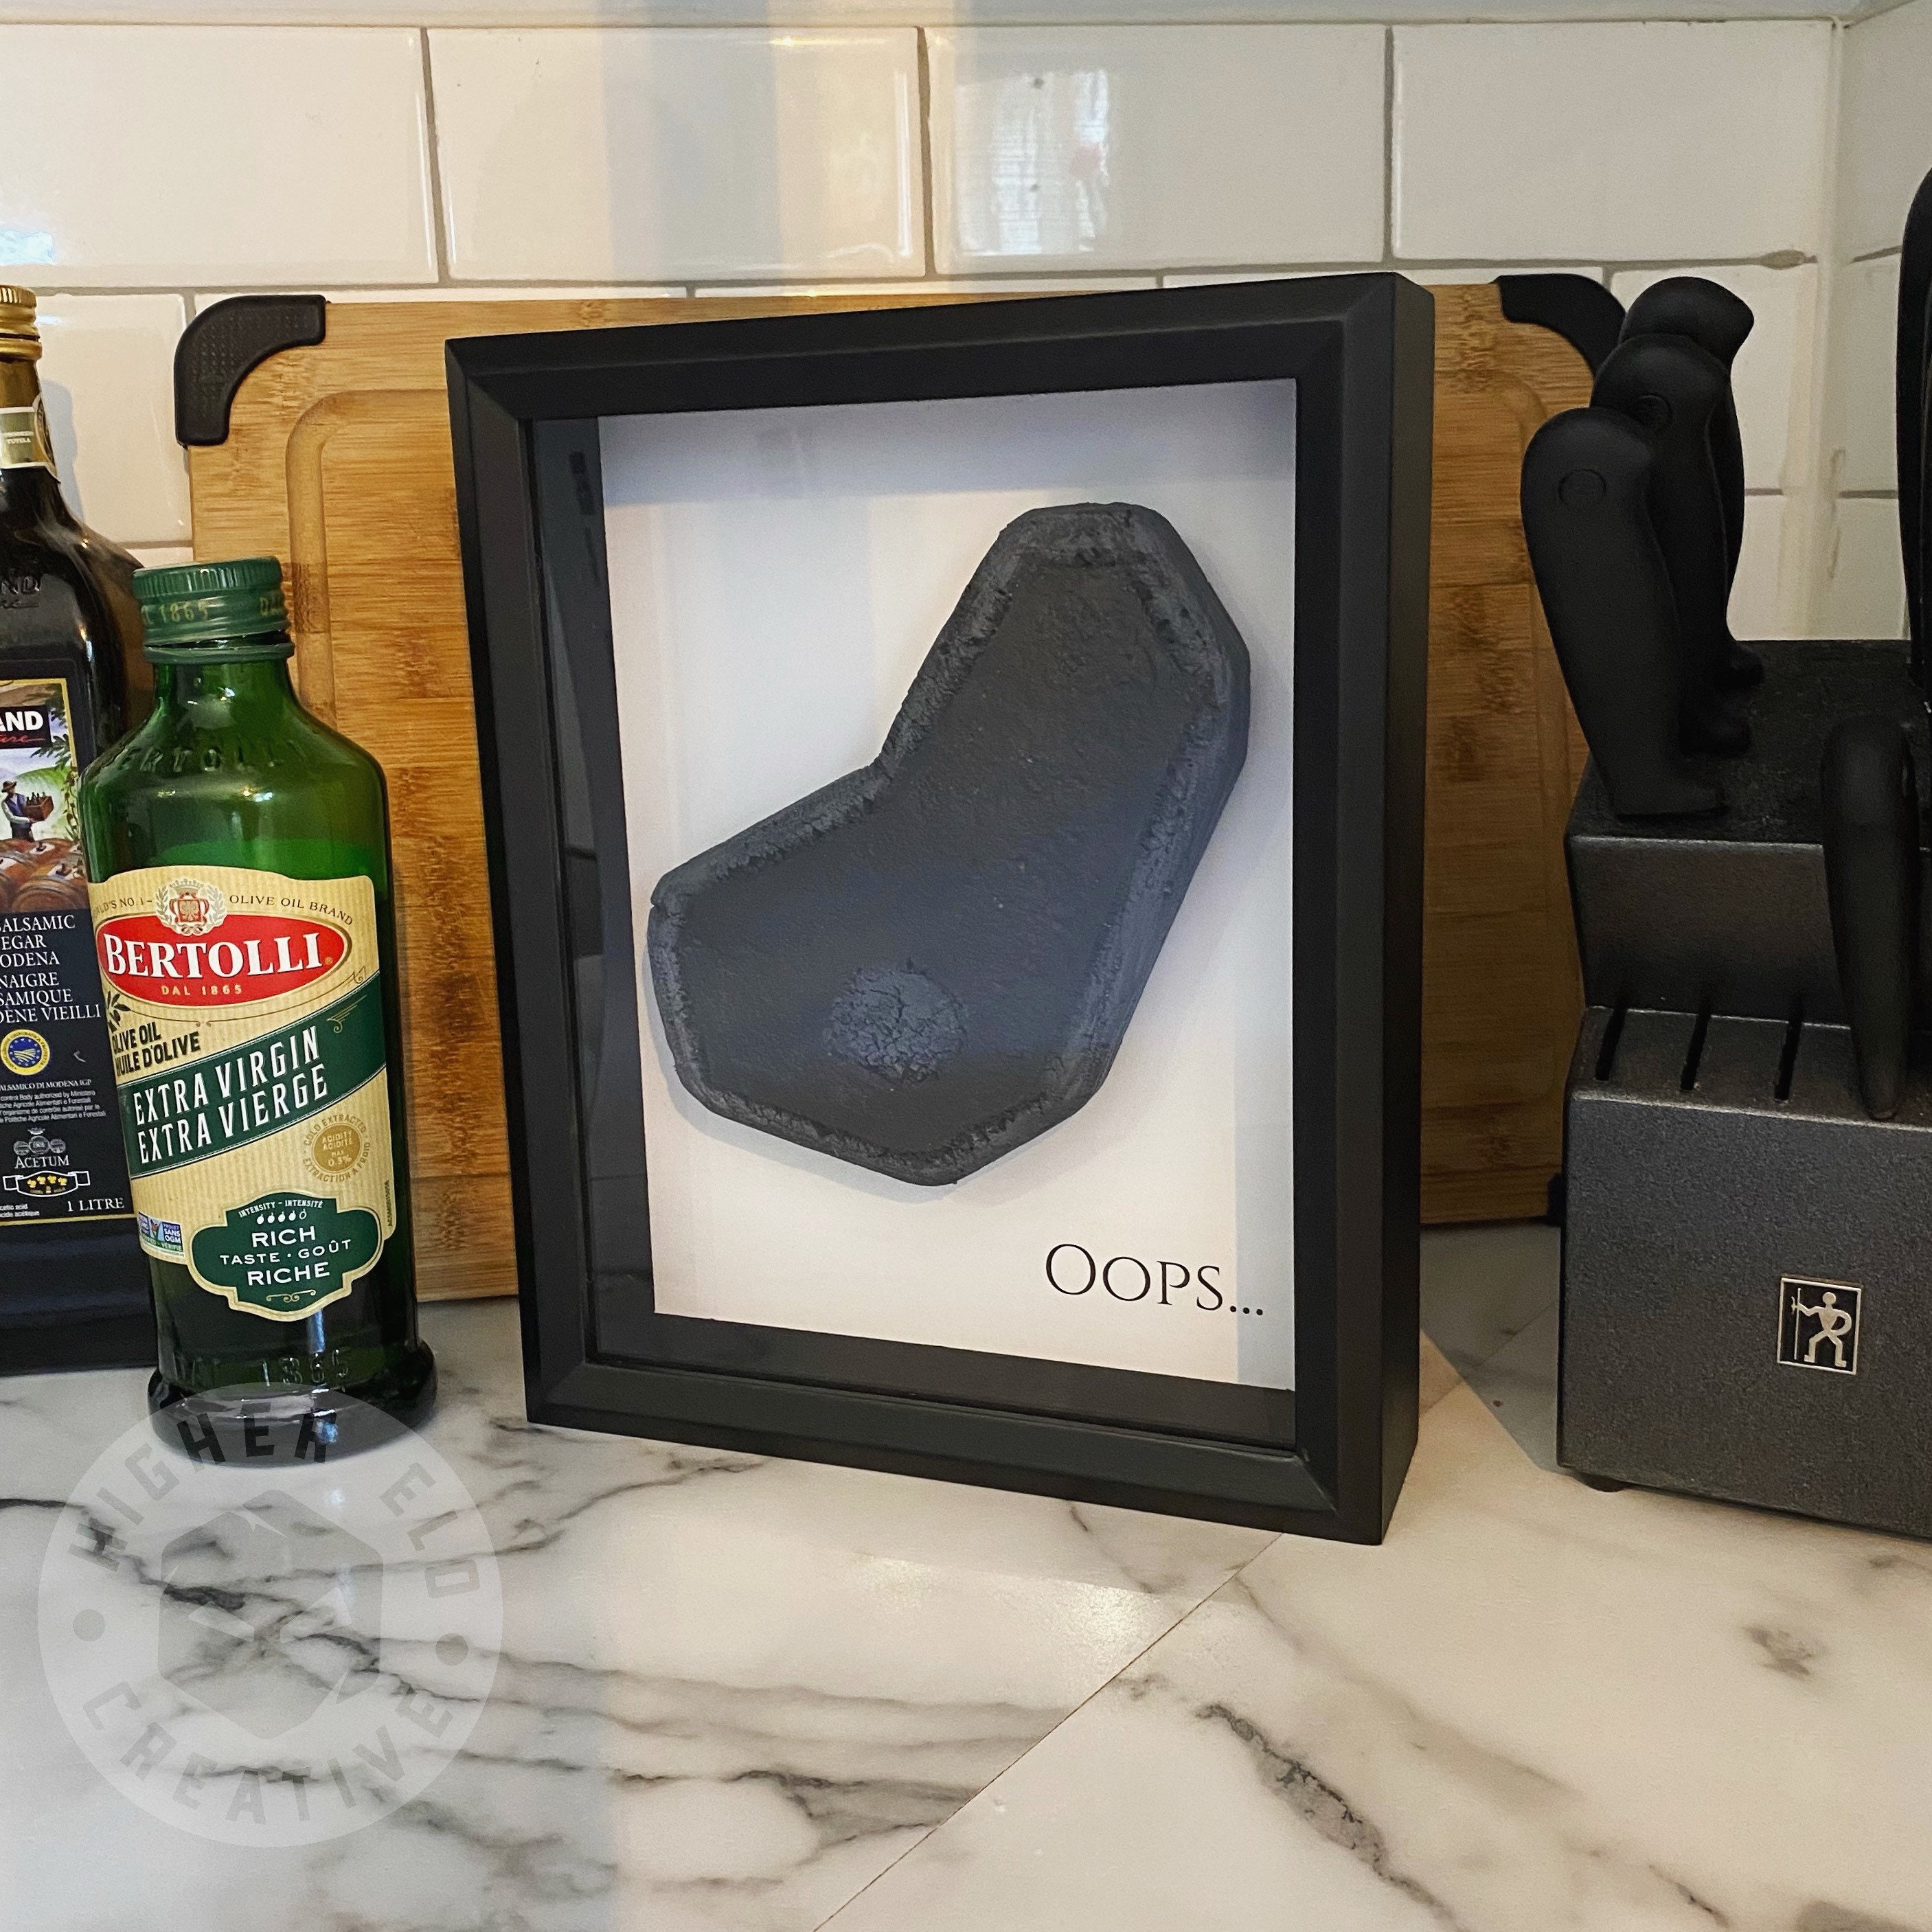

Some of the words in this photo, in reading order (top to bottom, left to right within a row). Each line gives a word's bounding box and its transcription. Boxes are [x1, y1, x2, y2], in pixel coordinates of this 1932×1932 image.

[229, 895, 275, 905] OLIVE
[280, 898, 304, 909] OIL
[309, 901, 353, 925] BRAND
[0, 914, 76, 933] ALSAMIC
[103, 933, 323, 979] BERTOLLI
[161, 985, 191, 996] DAL
[202, 984, 242, 996] 1865
[41, 1003, 102, 1021] VIEILLI
[112, 1028, 137, 1054] OLIVE
[139, 1021, 162, 1045] OIL
[115, 1051, 141, 1077] HUILE
[141, 1031, 201, 1067] D'OLIVE
[133, 1071, 209, 1126] EXTRA
[214, 1025, 321, 1099] VIRGIN
[137, 1112, 212, 1164] EXTRA
[218, 1062, 328, 1139] VIERGE
[321, 1113, 367, 1133] EXTRACTED
[14, 1155, 69, 1168] ACETUM
[303, 1158, 352, 1183] EXTRACTION
[356, 1142, 371, 1169] FROID
[67, 1201, 73, 1212] 1
[79, 1197, 125, 1212] LITRE
[238, 1201, 276, 1218] INTENSITY
[284, 1199, 323, 1209] INTENSITÉ
[163, 1228, 181, 1238] SANS
[165, 1234, 182, 1245] OGM
[251, 1225, 316, 1248] RICH
[220, 1252, 280, 1265] TASTE
[297, 1239, 351, 1259] GOÛT
[247, 1261, 330, 1286] RICHE
